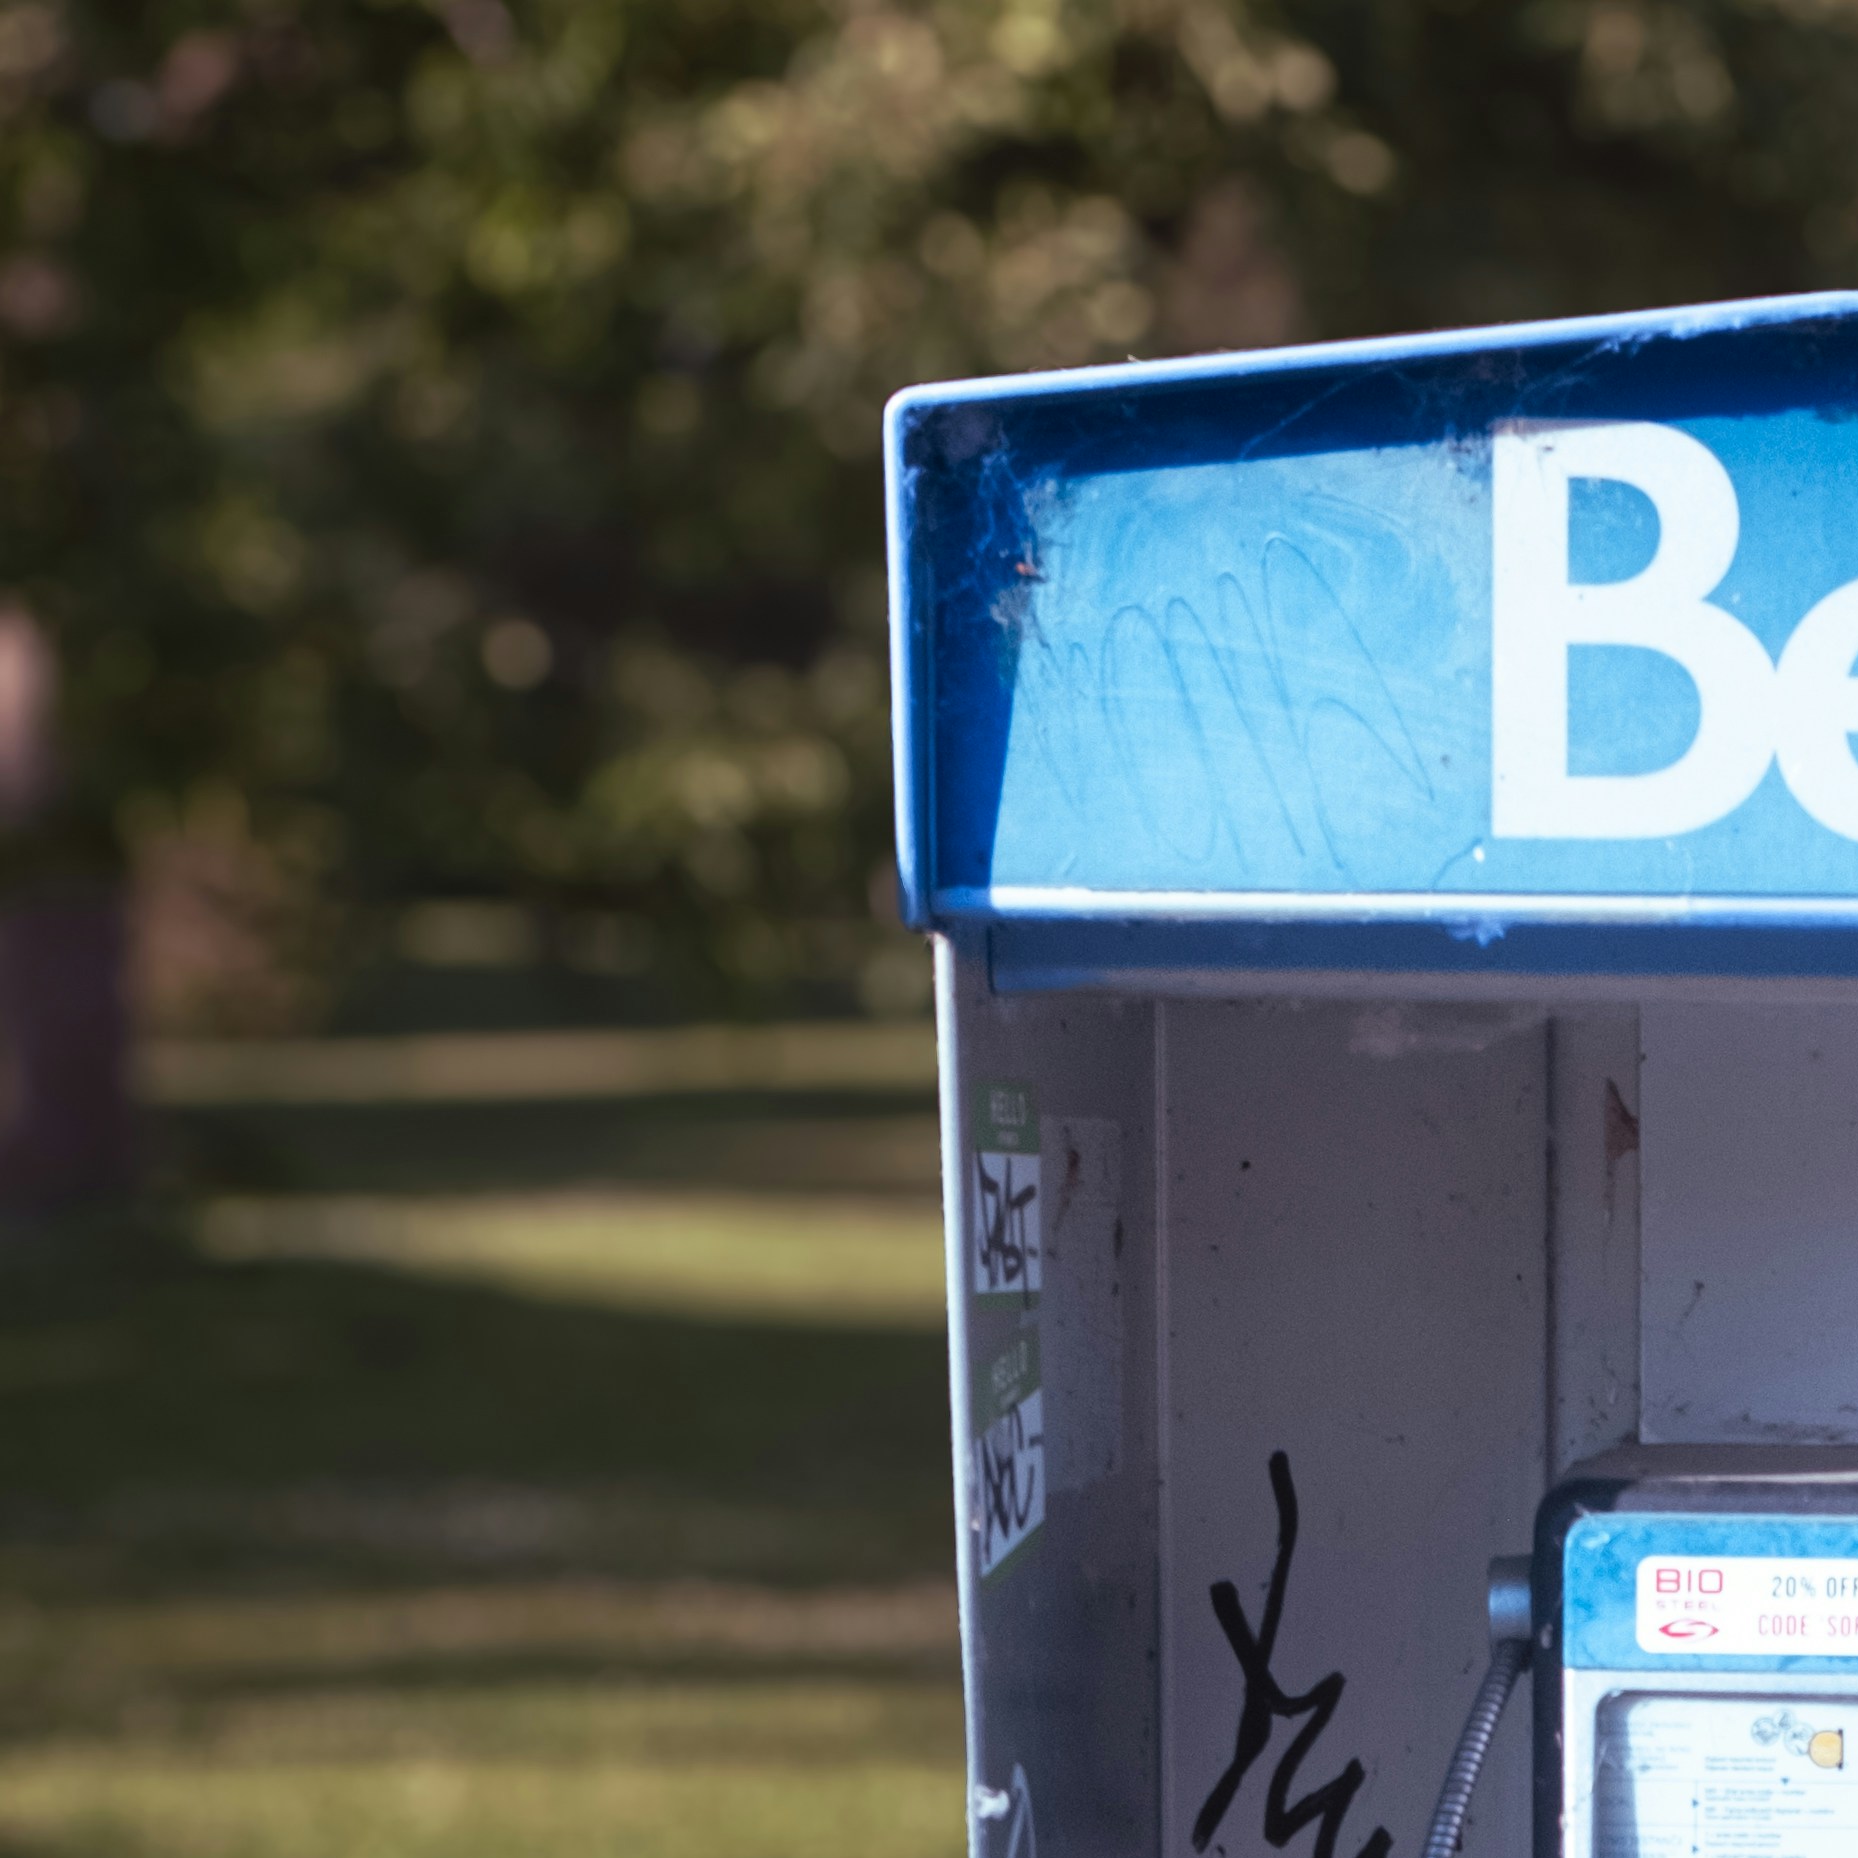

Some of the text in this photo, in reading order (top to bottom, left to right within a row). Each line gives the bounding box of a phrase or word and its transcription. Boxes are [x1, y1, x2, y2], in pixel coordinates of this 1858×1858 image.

[1655, 1568, 1724, 1594] BIO
[1771, 1576, 1817, 1598] 20%
[1758, 1614, 1808, 1636] CODE
